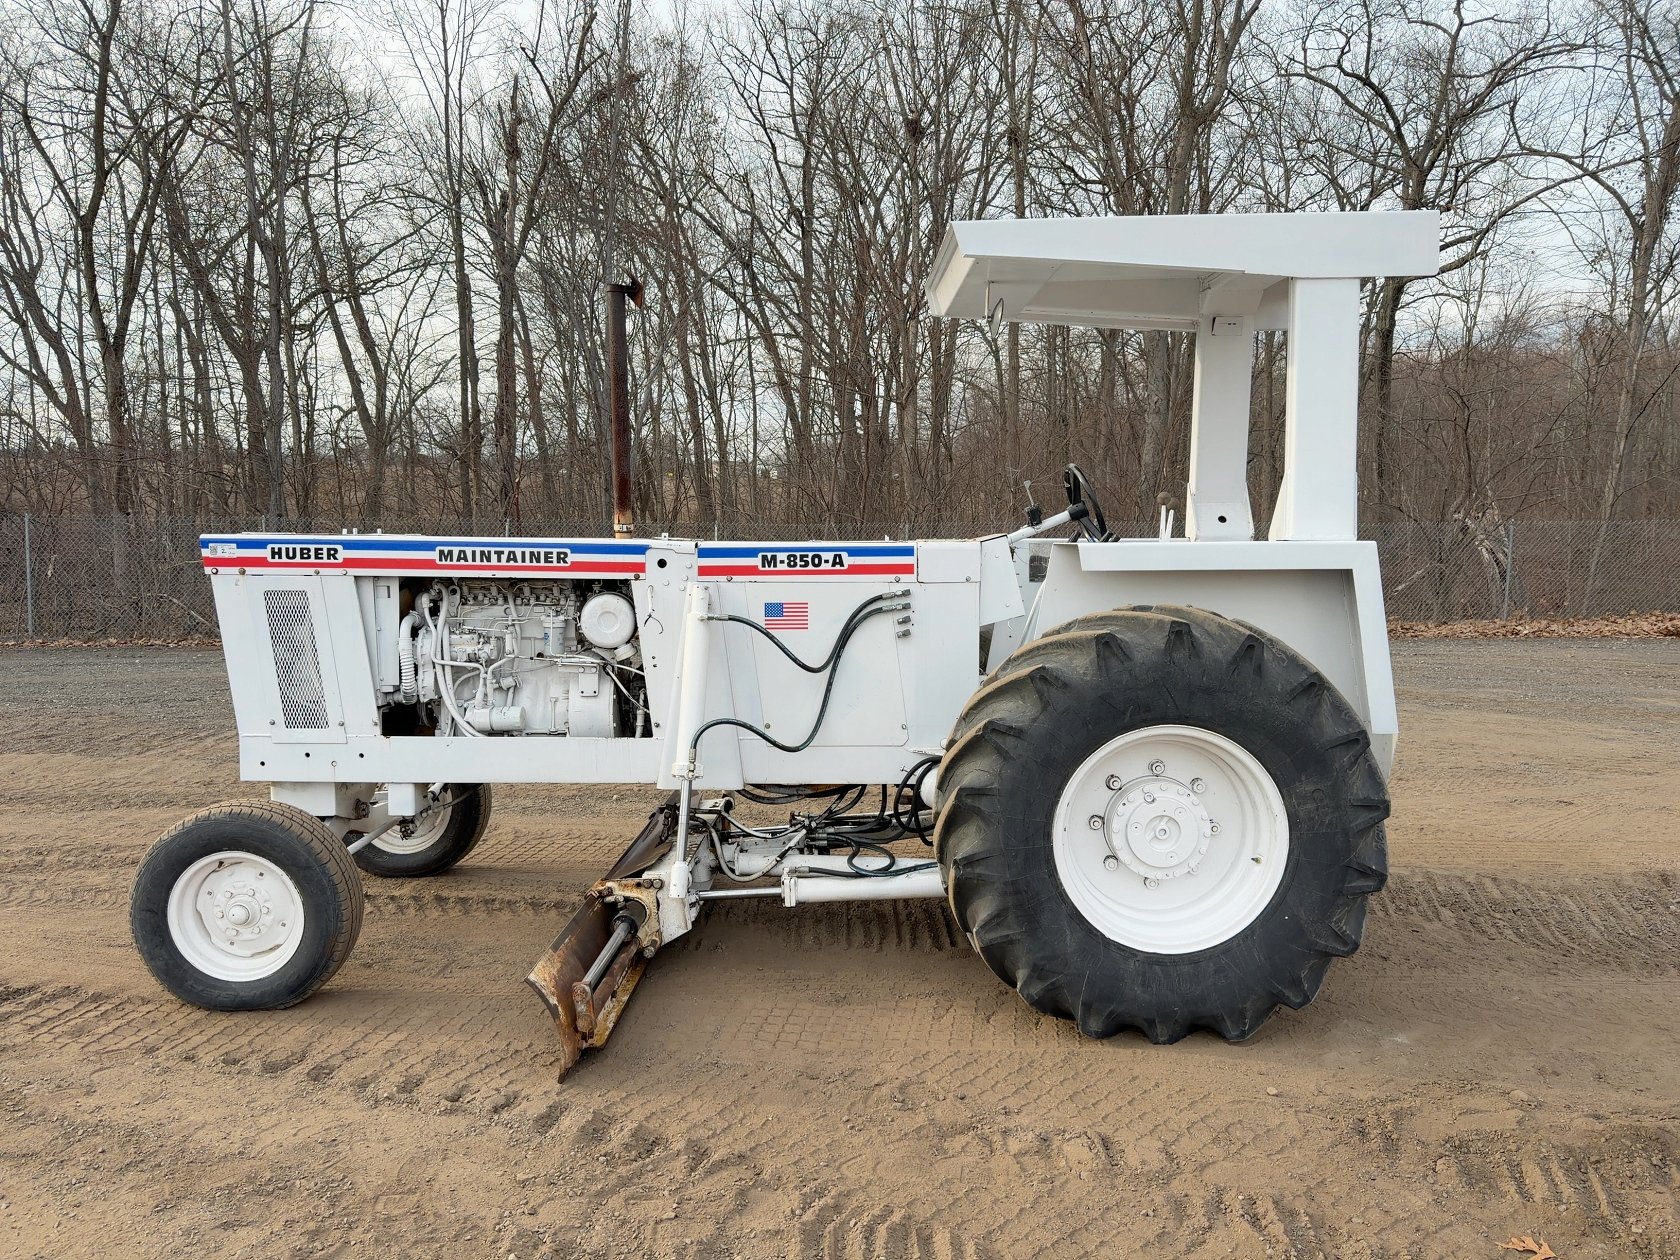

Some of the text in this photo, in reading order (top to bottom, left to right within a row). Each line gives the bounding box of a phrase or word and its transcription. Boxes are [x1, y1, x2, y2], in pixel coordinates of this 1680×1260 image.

[270, 546, 339, 561] HUBER
[438, 549, 569, 564] MAINTAINER
[761, 553, 845, 569] M-850-A
